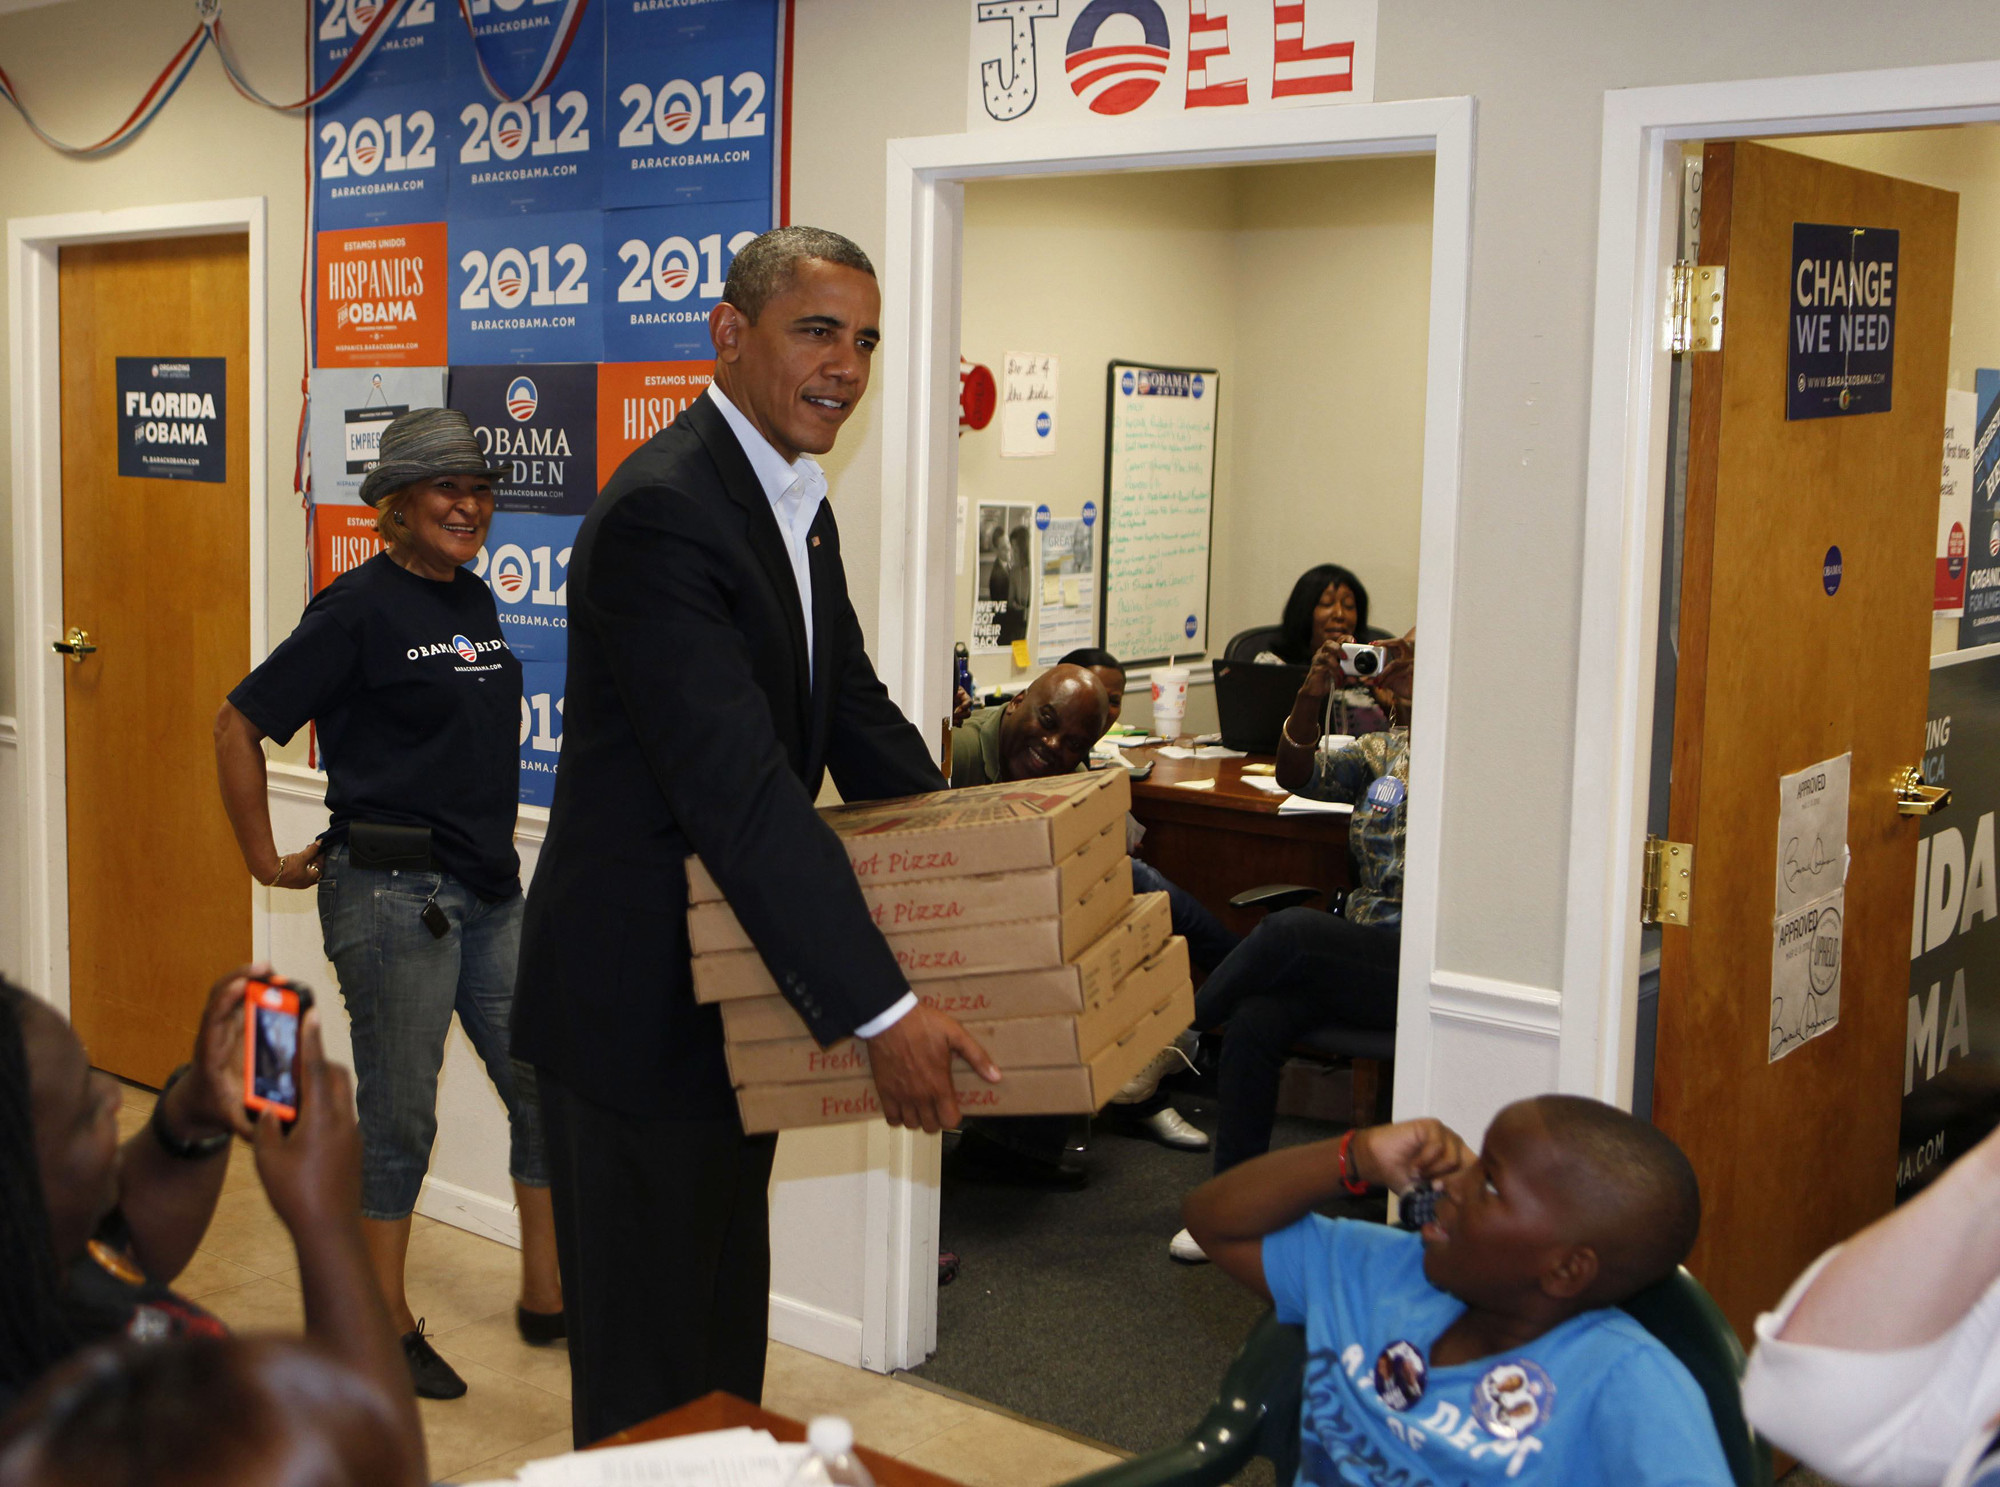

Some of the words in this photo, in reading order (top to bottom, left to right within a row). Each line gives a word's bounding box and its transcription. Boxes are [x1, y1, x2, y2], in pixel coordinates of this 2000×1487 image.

[978, 0, 1355, 121] JOEL
[619, 71, 766, 148] 2012
[459, 90, 590, 165] 2012
[320, 110, 436, 179] 2012
[631, 150, 751, 170] BARACKOBAMA.COM
[471, 164, 577, 184] BARACKOBAMA.COM
[331, 179, 424, 199] BARACKOBAMA.COM
[344, 240, 377, 252] ESTAMOS
[379, 237, 406, 249] UNIDOS
[329, 256, 424, 301] HISPANICS
[460, 243, 589, 310] 2012
[1796, 258, 1893, 308] CHANGE
[349, 300, 418, 324] OBAMA
[471, 316, 577, 331] BARACKOBAMA.COM
[1796, 314, 1832, 354] WE
[1839, 313, 1890, 353] NEED
[645, 376, 686, 386] ESTAMOS
[1151, 373, 1189, 388] OBAMA
[126, 391, 217, 419] FLORIDA
[624, 397, 697, 440] HISP
[145, 421, 208, 446] OBAMA
[350, 431, 382, 451] EMPRES
[473, 426, 573, 457] OBAMA
[332, 535, 390, 573] HISPA
[975, 612, 995, 625] GOT
[977, 600, 1007, 613] WE'VE
[974, 624, 1001, 636] THEIR
[974, 636, 999, 648] BACK
[407, 643, 456, 661] OBAMA
[454, 663, 502, 672] BARACKOBAMA.COM
[1925, 716, 1951, 751] ING
[1797, 773, 1826, 800] APPROVED
[889, 849, 960, 874] Pizza
[1910, 811, 1998, 961] IDA
[894, 899, 966, 924] Pizza
[1779, 909, 1819, 948] APPROVED
[897, 948, 968, 970] Pizza
[1904, 967, 1970, 1097] MA
[808, 1043, 867, 1073] Fresh
[822, 1088, 878, 1117] Fresh
